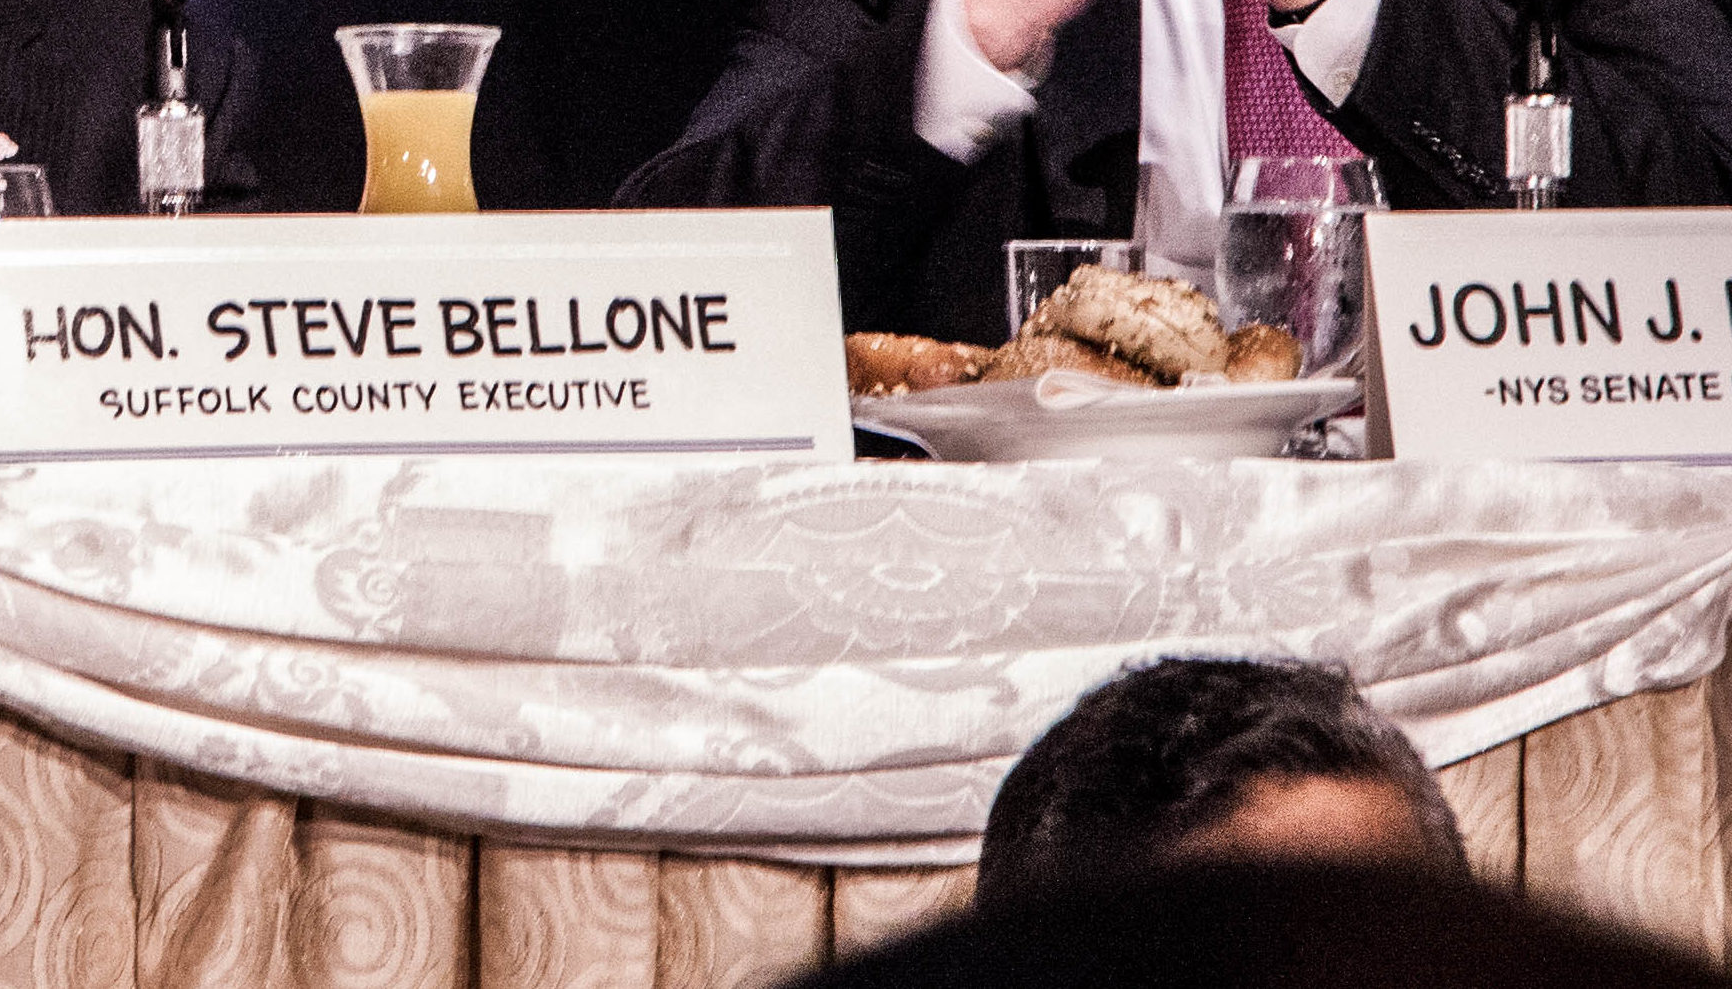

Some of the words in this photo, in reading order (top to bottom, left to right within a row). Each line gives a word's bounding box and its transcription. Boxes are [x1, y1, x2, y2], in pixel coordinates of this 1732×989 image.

[23, 300, 179, 362] HON.
[206, 298, 423, 362] STEVE
[437, 292, 737, 358] BELLONE
[1408, 278, 1623, 349] JOHN
[1645, 277, 1703, 344] J.
[99, 384, 272, 419] SUFFOLK
[291, 381, 438, 414] COUNTY
[457, 379, 651, 412] EXECUTIVE
[1485, 375, 1569, 406] -NYS
[1580, 371, 1722, 404] SENATE
